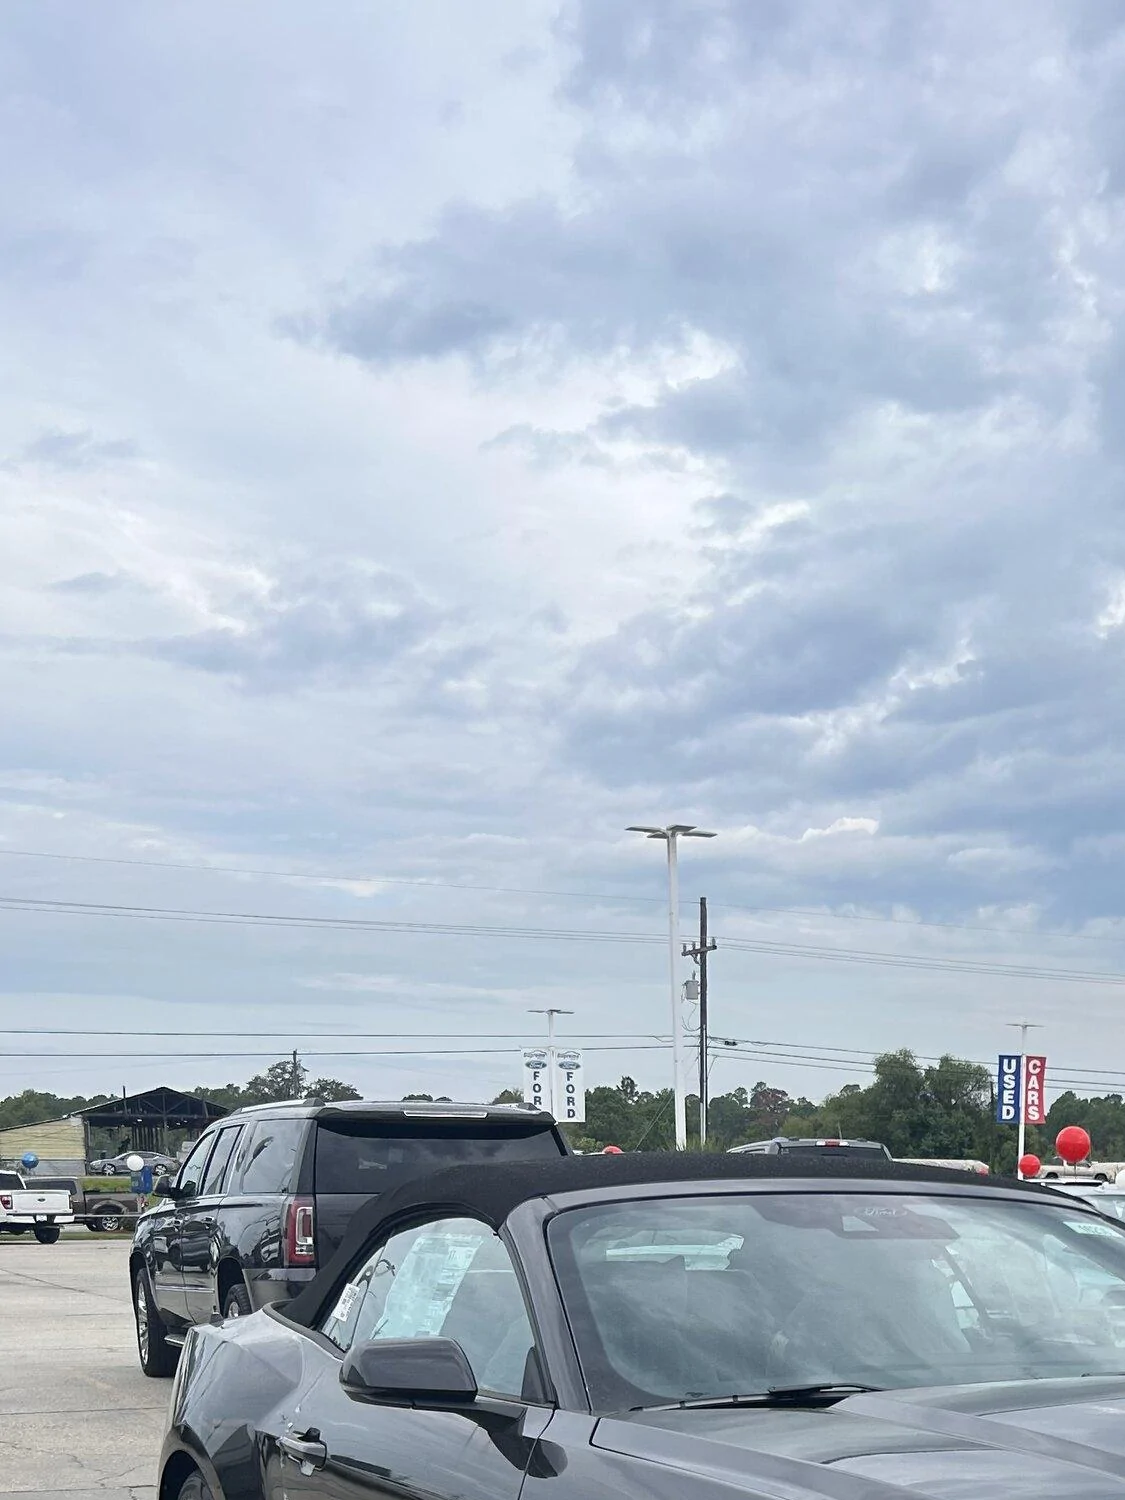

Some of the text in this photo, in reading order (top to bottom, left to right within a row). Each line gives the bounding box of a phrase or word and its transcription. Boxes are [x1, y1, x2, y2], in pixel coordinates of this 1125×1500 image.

[566, 1072, 575, 1119] FORD
[1002, 1058, 1017, 1120] USED
[1027, 1059, 1042, 1121] CARS
